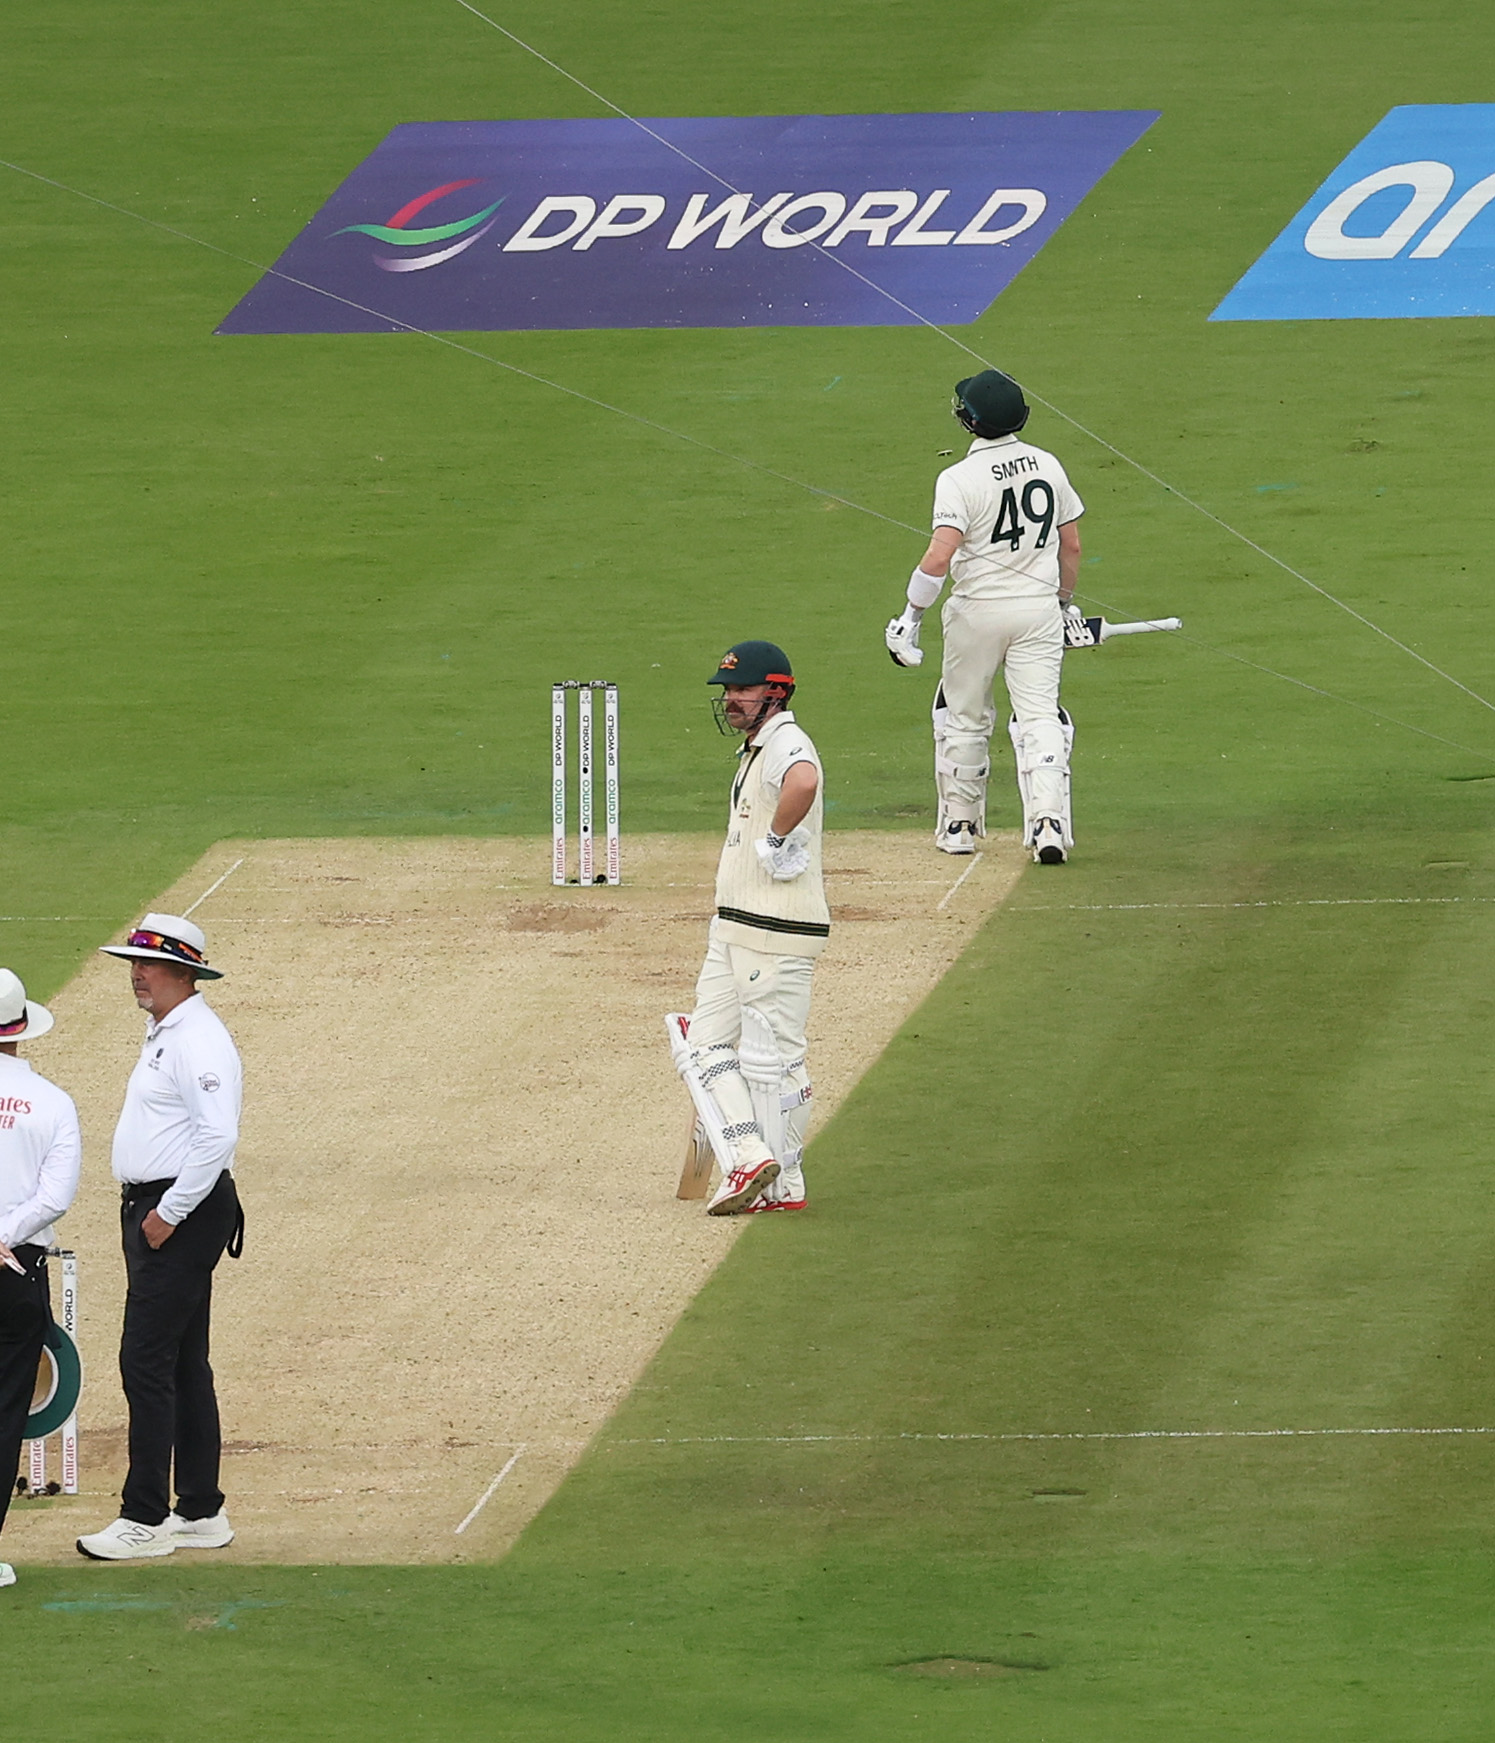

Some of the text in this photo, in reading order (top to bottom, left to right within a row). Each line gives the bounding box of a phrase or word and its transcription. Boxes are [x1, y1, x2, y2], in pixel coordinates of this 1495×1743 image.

[502, 188, 1047, 252] DP WORLD
[990, 478, 1055, 552] 49
[554, 714, 563, 752] WORLD
[582, 714, 590, 752] WORLD
[607, 714, 615, 752] WORLD
[554, 752, 563, 767] DP
[554, 778, 564, 825] aramco
[582, 779, 591, 825] aramco
[607, 778, 617, 825] aramco
[555, 837, 564, 880] Emirates
[582, 837, 592, 880] Emirates
[609, 837, 618, 880] Emirates
[64, 1288, 74, 1332] WORLD
[31, 1440, 42, 1487] Emirate
[64, 1436, 75, 1487] Emirates
